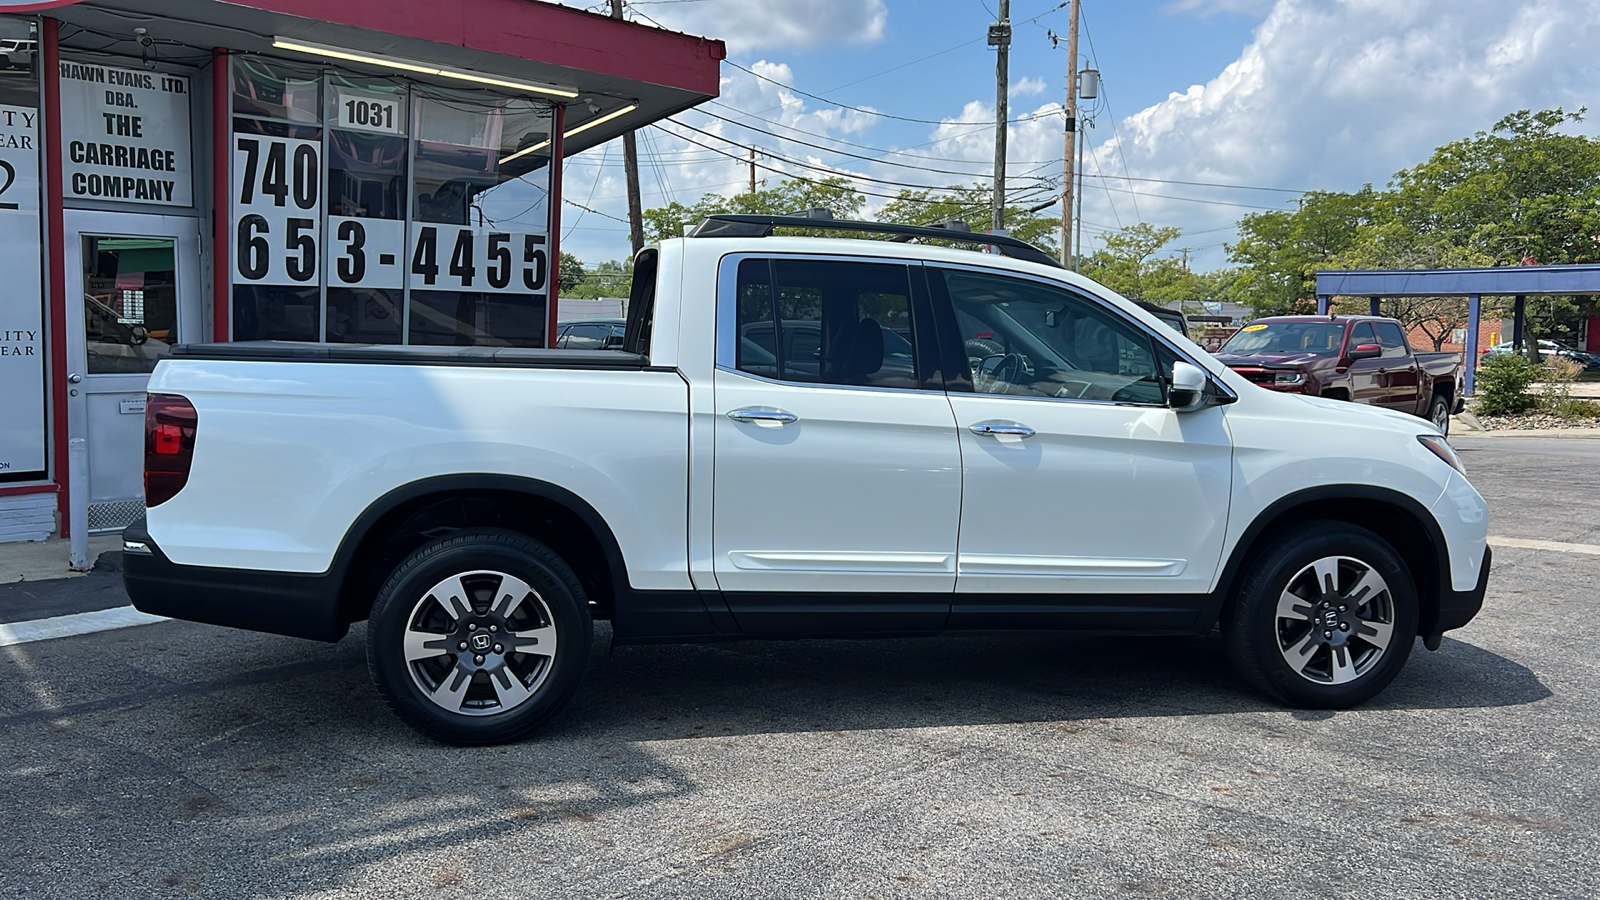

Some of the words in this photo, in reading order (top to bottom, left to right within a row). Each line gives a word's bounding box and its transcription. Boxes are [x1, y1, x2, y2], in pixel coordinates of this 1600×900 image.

[59, 62, 105, 83] HAWN
[108, 69, 156, 90] EVANS.
[161, 77, 187, 94] LTD.
[105, 90, 138, 108] DBA.
[103, 112, 143, 138] THE
[345, 100, 393, 128] 1031
[69, 140, 176, 172] CARRIAGE
[71, 172, 175, 202] COMPANY
[237, 138, 318, 209] 740
[0, 330, 37, 341] ITY
